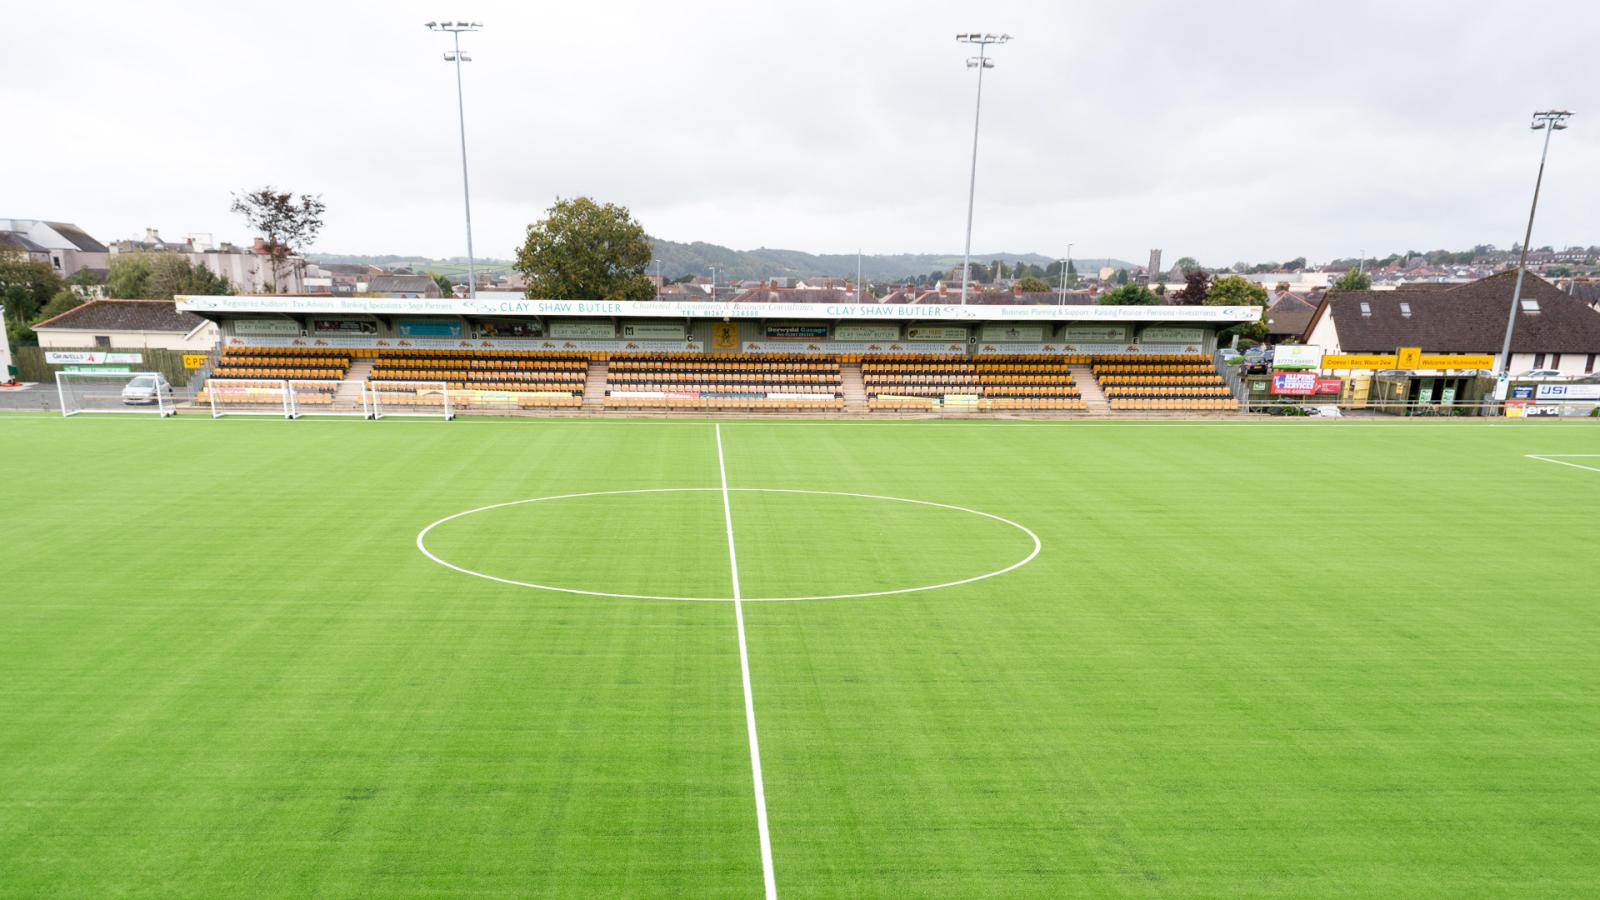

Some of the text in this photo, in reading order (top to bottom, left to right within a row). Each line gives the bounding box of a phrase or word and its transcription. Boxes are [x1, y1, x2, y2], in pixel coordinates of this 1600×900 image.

[500, 302, 622, 313] CLAY SHAW BUTLER
[826, 306, 942, 316] CLAY SHAW BUTLER
